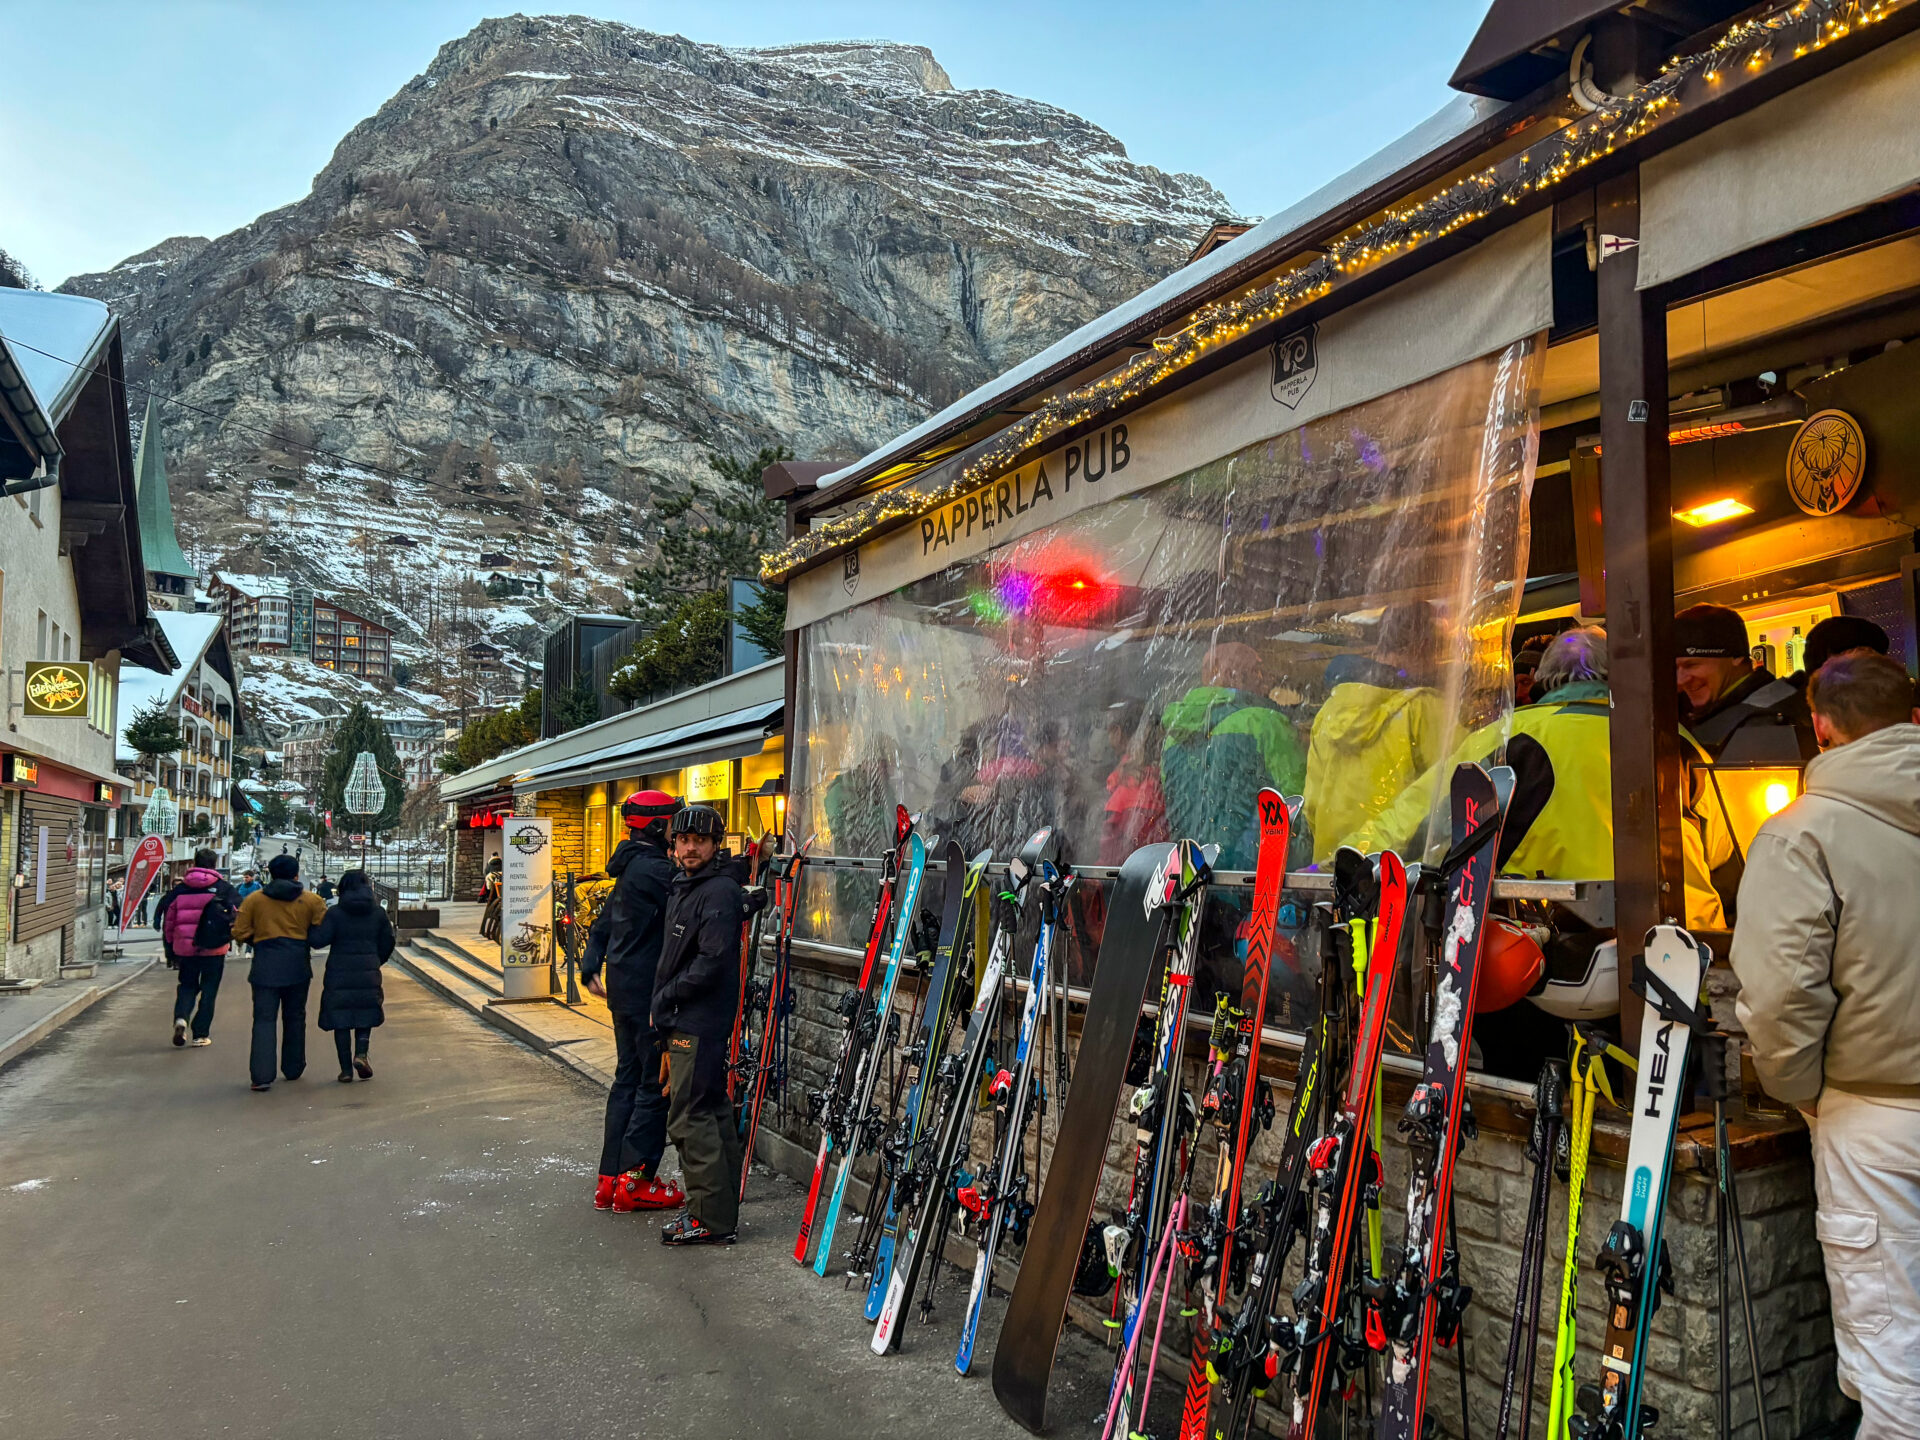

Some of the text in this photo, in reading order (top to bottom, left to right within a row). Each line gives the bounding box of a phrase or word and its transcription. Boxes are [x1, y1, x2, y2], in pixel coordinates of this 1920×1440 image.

[1280, 376, 1308, 392] PAPPERLA
[1287, 387, 1300, 397] PUB
[920, 423, 1131, 556] PAPPERLA PUB
[511, 836, 547, 845] BIKE SHOP
[1452, 797, 1480, 973] FCHR
[871, 901, 880, 924] LEKI
[890, 867, 919, 966] HEAD
[1383, 902, 1394, 943] ATOMIC
[1239, 1018, 1254, 1033] GS
[1644, 1020, 1674, 1119] HEA
[1635, 1175, 1643, 1197] SUPER
[1640, 1177, 1648, 1199] SHAPE
[879, 1308, 893, 1340] SC
